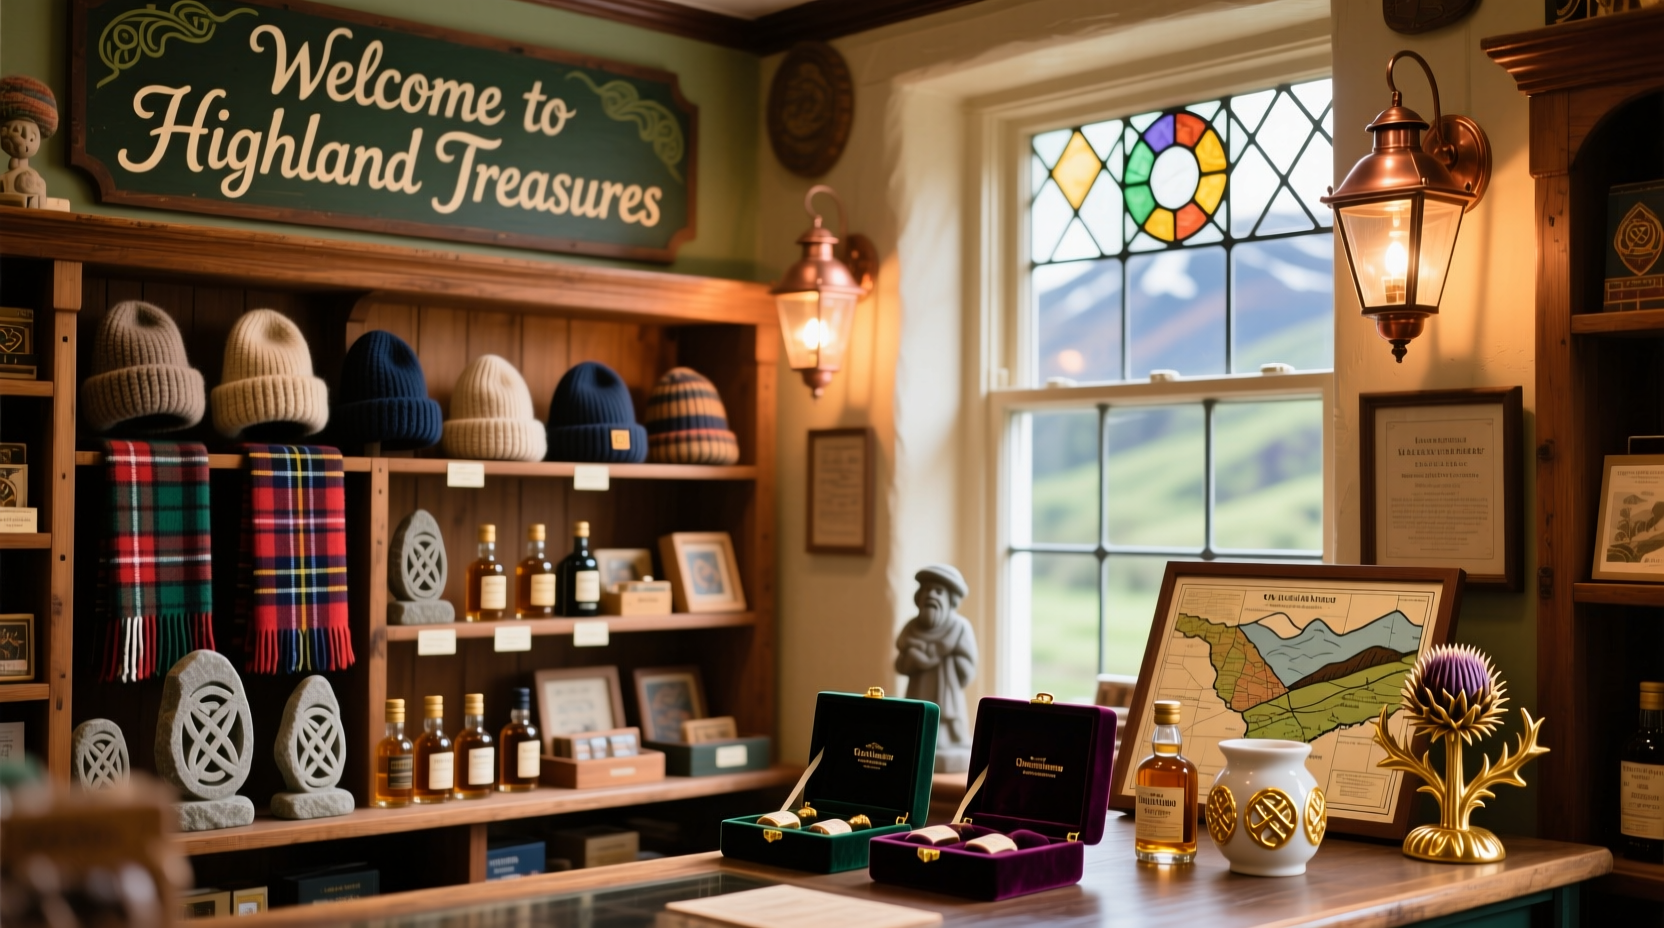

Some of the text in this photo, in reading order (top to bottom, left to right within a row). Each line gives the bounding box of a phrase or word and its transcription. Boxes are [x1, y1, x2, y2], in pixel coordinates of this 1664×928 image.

[249, 24, 576, 136] Welcome to
[117, 85, 662, 227] Highland Treasures
